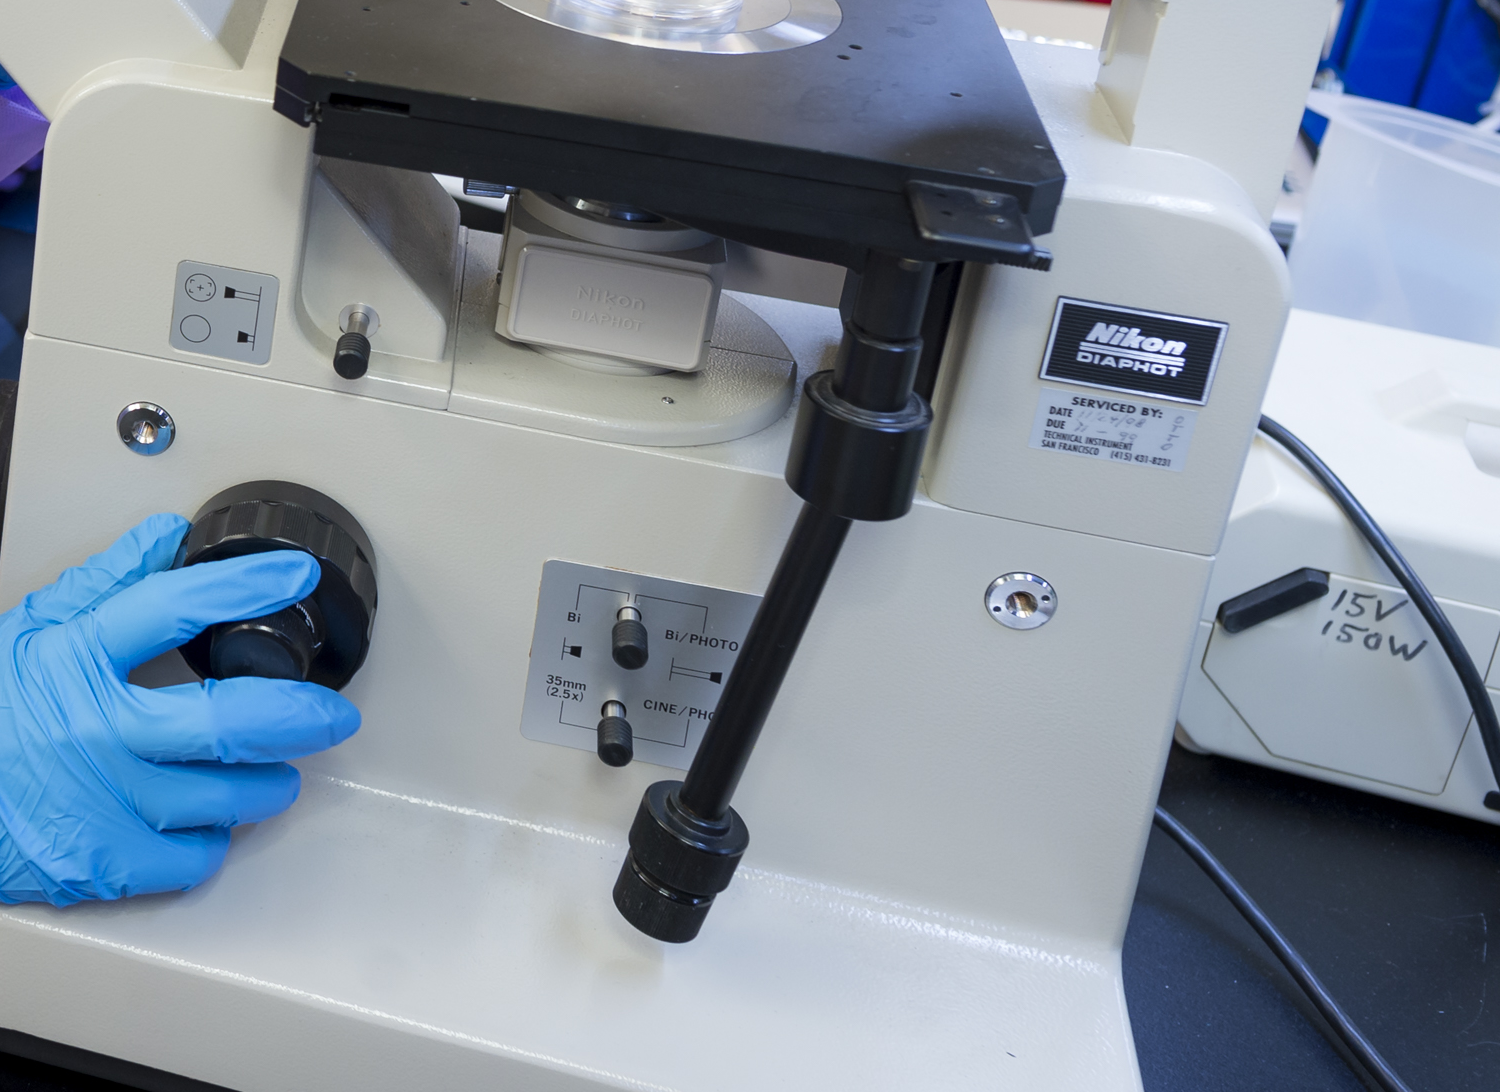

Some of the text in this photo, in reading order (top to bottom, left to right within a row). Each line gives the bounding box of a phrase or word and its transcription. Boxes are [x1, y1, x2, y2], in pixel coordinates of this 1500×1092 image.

[576, 285, 645, 310] Nikon
[569, 307, 643, 332] DIAPHOT
[1085, 322, 1187, 356] Nikon
[1076, 352, 1183, 377] DIAPHOT
[1048, 406, 1074, 417] DATE
[1071, 396, 1163, 419] SERVICED BY:
[1046, 418, 1066, 430] DUE
[1041, 439, 1057, 449] SAN
[1058, 441, 1100, 456] FRANCISCO
[1110, 450, 1133, 461] (415)
[1044, 429, 1134, 451] TECHNICAL INSTRUMENT
[1331, 588, 1409, 622] 15V
[566, 611, 581, 624] Bi
[664, 629, 739, 653] Bi/PHOTO
[1321, 619, 1428, 662] 150W
[546, 674, 587, 691] 35mm
[546, 685, 584, 703] (2.5x)
